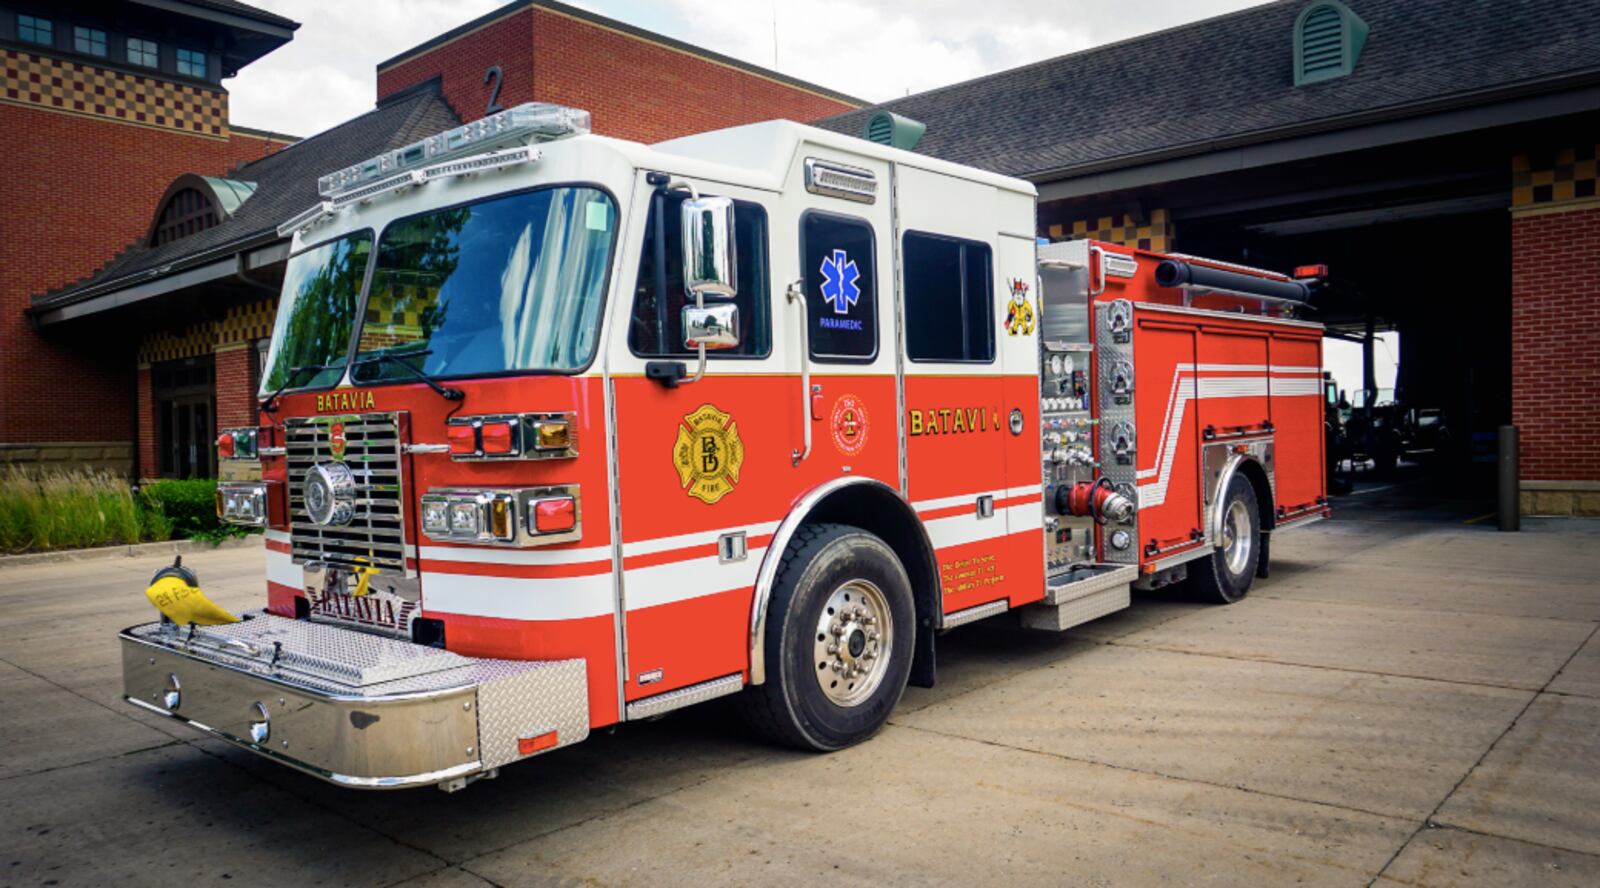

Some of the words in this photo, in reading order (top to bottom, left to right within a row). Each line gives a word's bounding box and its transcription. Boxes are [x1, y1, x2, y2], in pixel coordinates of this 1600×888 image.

[484, 65, 504, 116] 2
[820, 317, 862, 330] PARAMEDIC
[317, 390, 375, 412] BATAVIA
[693, 412, 723, 426] BATAVIA
[702, 483, 720, 493] FIRE
